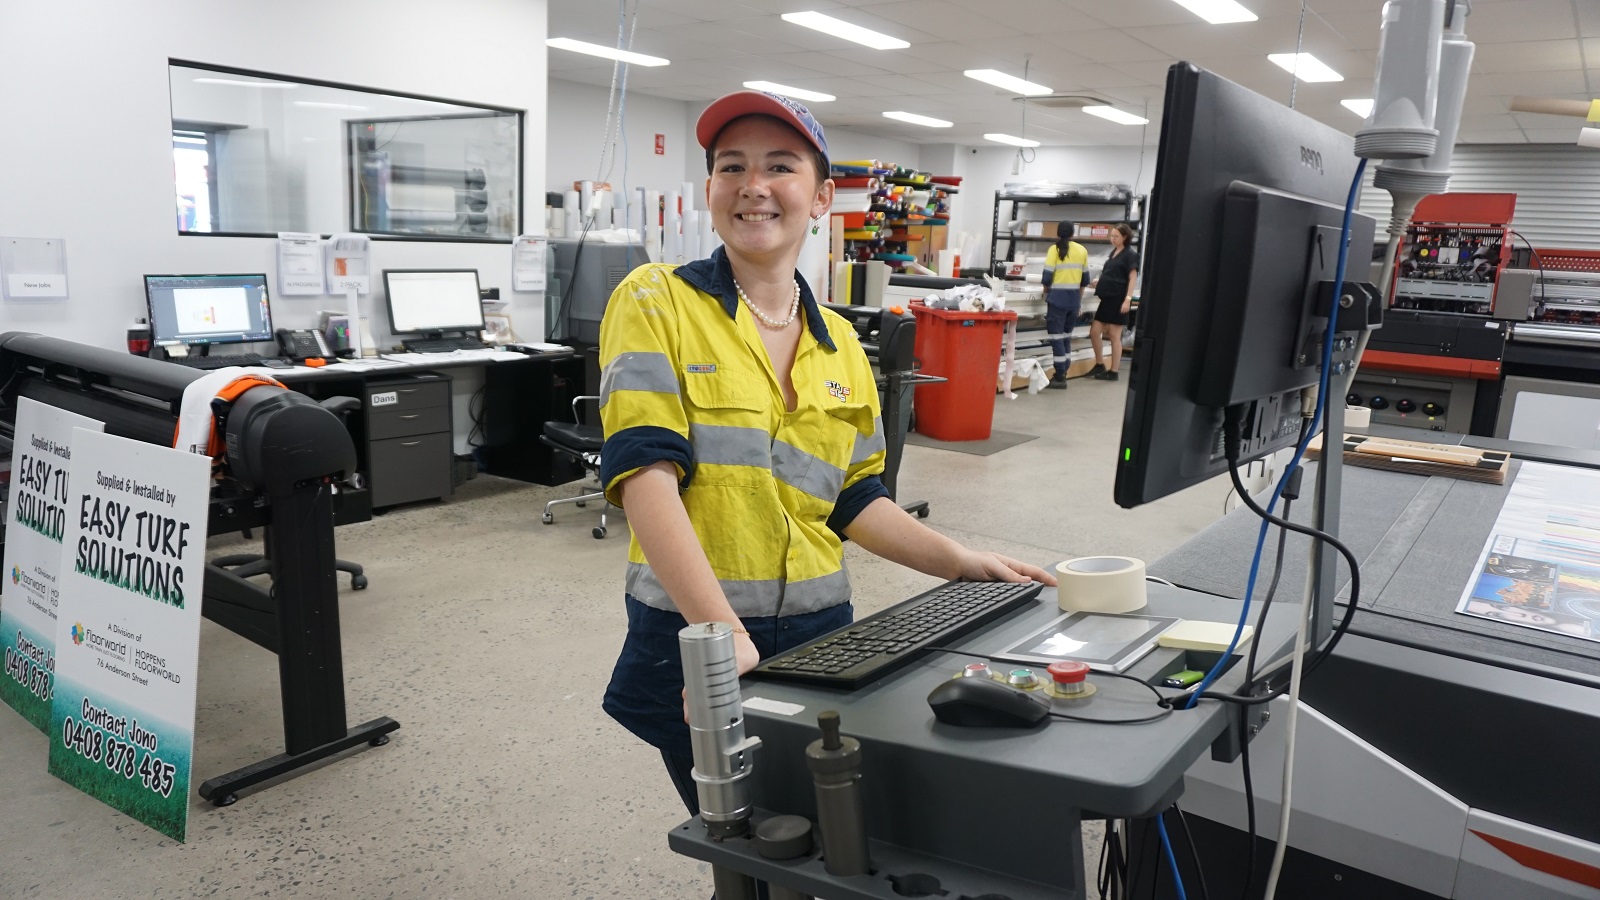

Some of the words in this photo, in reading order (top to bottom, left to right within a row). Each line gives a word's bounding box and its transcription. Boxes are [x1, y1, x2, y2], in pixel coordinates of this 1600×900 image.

[373, 395, 396, 404] Dans
[31, 433, 49, 452] Supplied
[53, 441, 71, 460] Installe
[19, 453, 52, 496] EASY
[54, 468, 70, 505] TU
[96, 470, 124, 491] Supplied
[125, 479, 132, 493] &
[132, 480, 165, 503] Installed
[166, 489, 176, 508] by
[16, 489, 66, 543] SOLUTIO
[80, 494, 131, 542] EASY
[135, 510, 190, 561] TURF
[75, 535, 184, 608] SOLUTIONS
[48, 608, 58, 621] Stree
[108, 623, 113, 631] A
[113, 624, 135, 640] Division
[135, 633, 142, 642] of
[17, 629, 45, 667] Contact
[135, 648, 166, 668] HOPPENS
[5, 646, 29, 687] 0408
[30, 664, 49, 701] 878
[96, 657, 104, 668] 76
[104, 662, 131, 679] Anderson
[131, 672, 149, 687] Street
[134, 658, 181, 684] FLOORWORLD
[82, 697, 127, 739] Contact
[128, 718, 157, 753] Jono
[64, 716, 103, 763] 0408
[105, 736, 135, 779] 878
[139, 752, 175, 798] 485
